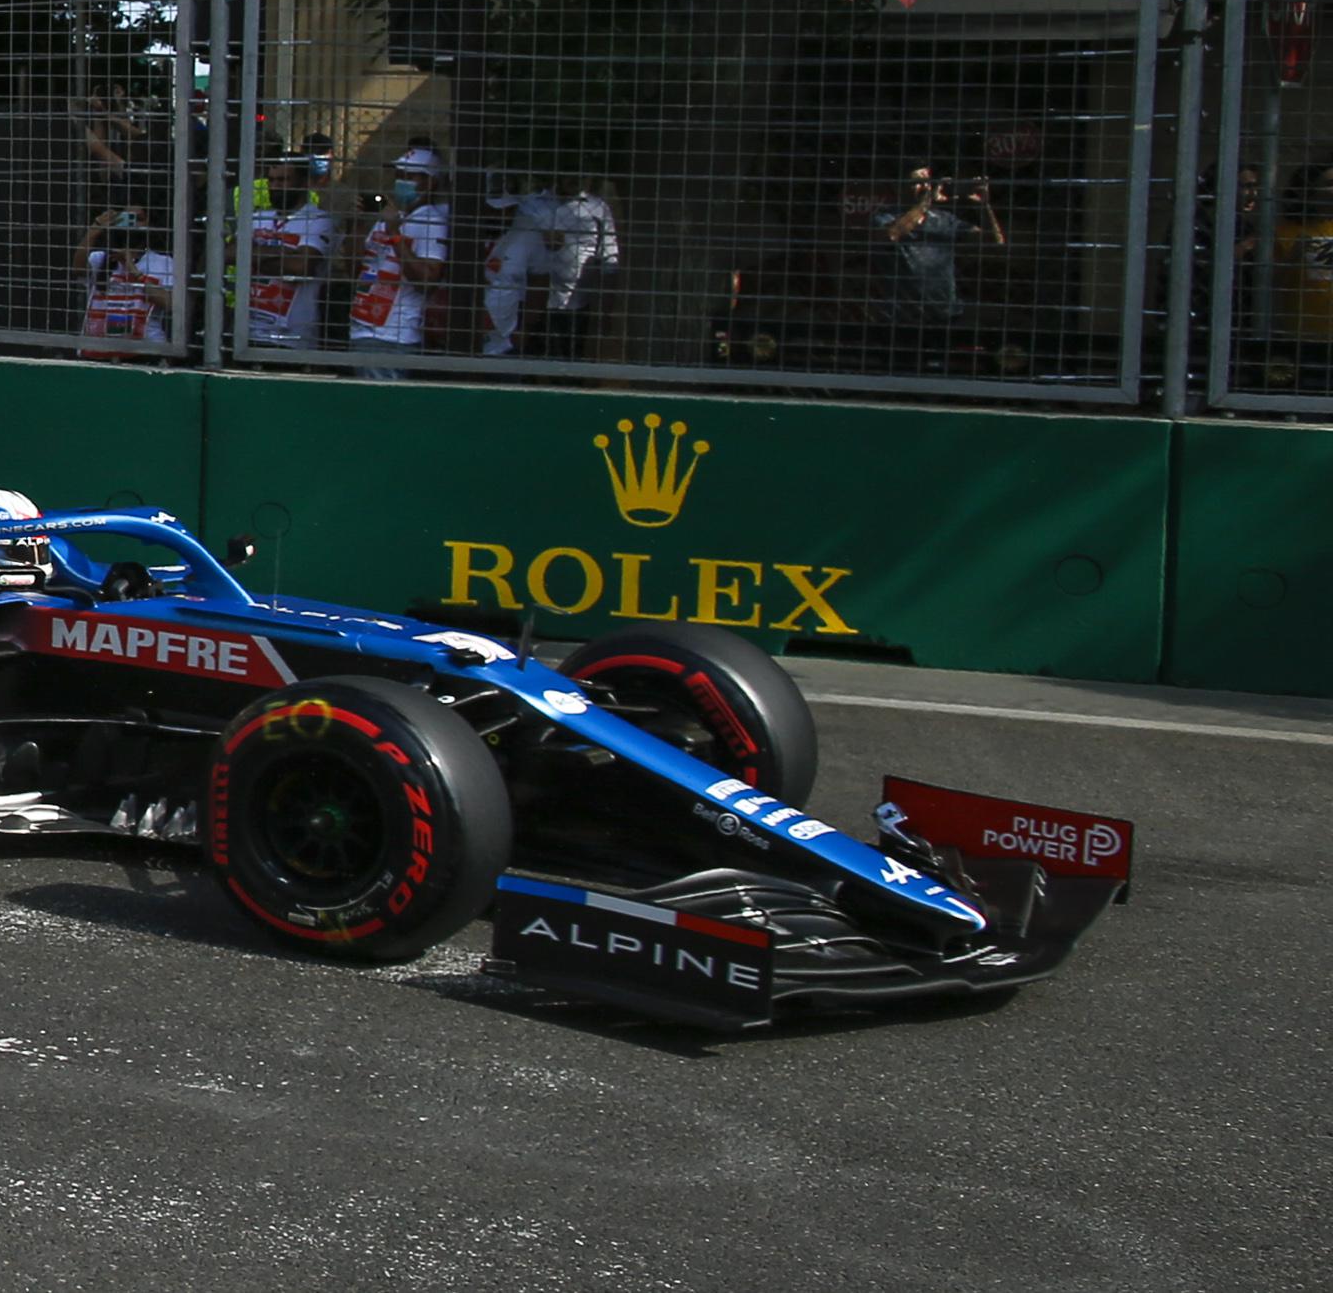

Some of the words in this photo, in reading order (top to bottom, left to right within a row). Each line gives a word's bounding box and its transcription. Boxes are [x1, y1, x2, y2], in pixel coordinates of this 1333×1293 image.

[440, 540, 859, 634] ROLEX
[51, 617, 249, 677] MAPFRE
[388, 781, 434, 915] ZERO
[983, 829, 1077, 863] POWER
[1013, 816, 1078, 842] PLUG
[519, 917, 761, 990] ALPINE
